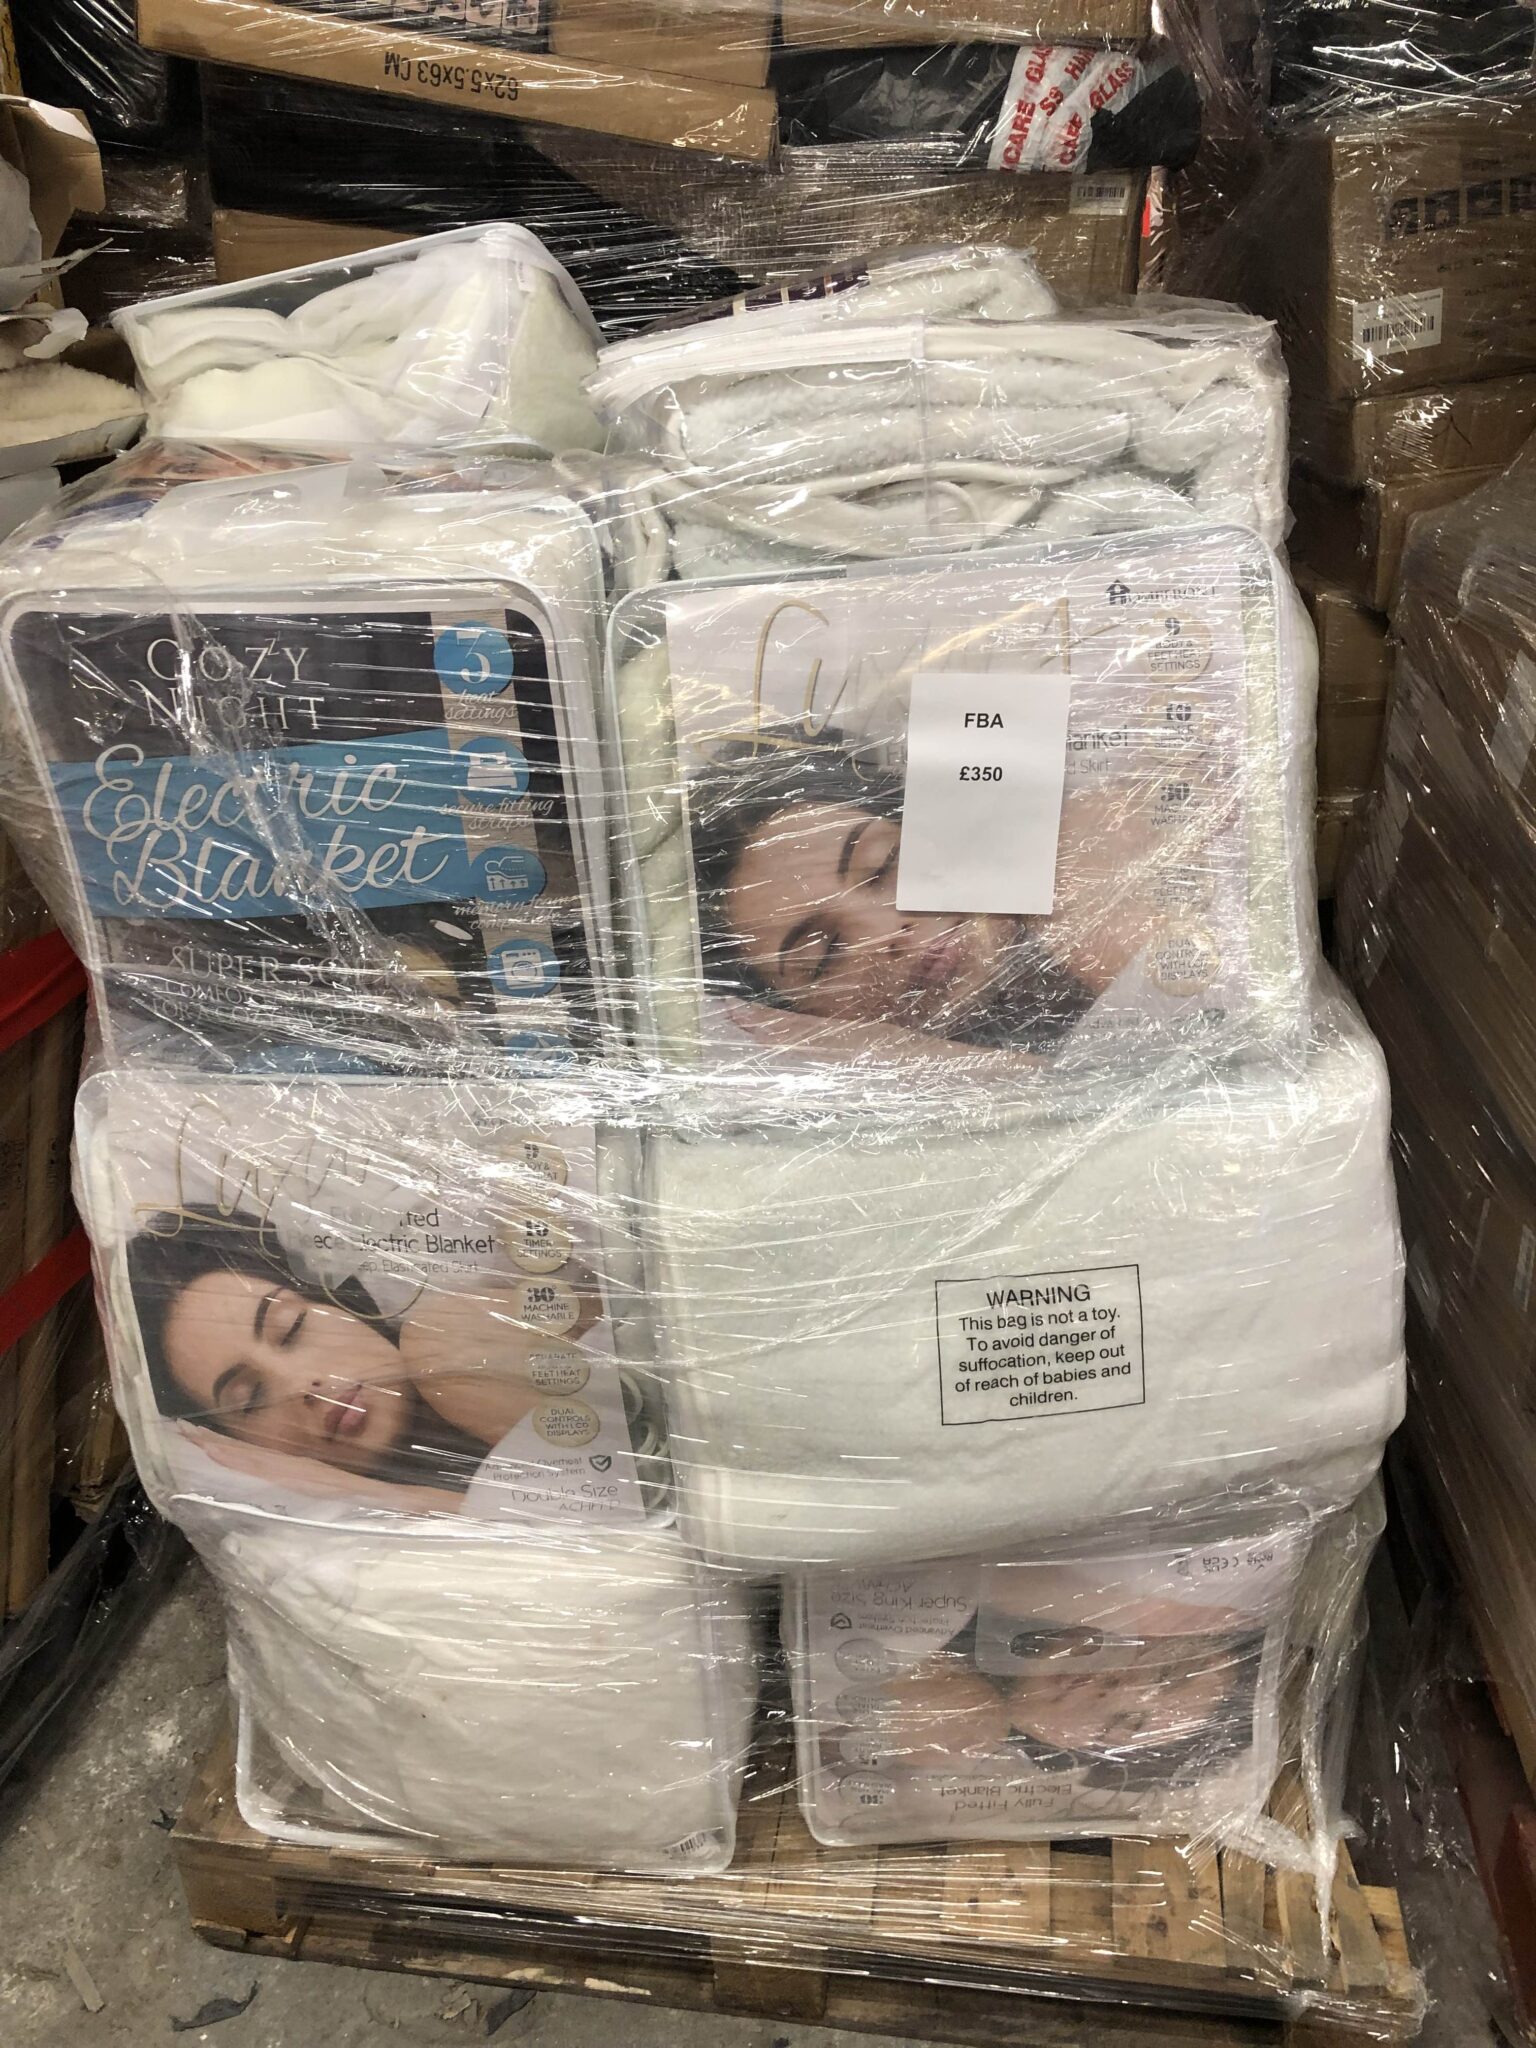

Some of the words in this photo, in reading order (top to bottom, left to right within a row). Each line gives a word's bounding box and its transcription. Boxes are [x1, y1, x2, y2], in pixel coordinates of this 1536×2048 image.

[1002, 99, 1036, 165] CARE
[147, 638, 309, 682] COZY
[456, 630, 491, 684] 3
[1150, 659, 1201, 672] SETTINGS
[444, 703, 518, 724] settings
[964, 712, 1004, 729] FBA
[959, 765, 1003, 782] £350
[83, 743, 408, 843] Elecric
[496, 797, 554, 816] fitting
[168, 944, 283, 985] SUPER
[425, 1233, 496, 1255] Blanket
[987, 1284, 1091, 1310] WARNING
[523, 1303, 570, 1313] MACHINE
[958, 1316, 993, 1332] This
[997, 1314, 1027, 1331] bag
[1031, 1312, 1044, 1327] is
[1047, 1310, 1074, 1325] not
[1078, 1311, 1088, 1322] a
[1092, 1307, 1121, 1323] toy.
[966, 1337, 988, 1352] To
[992, 1333, 1035, 1351] avoid
[1039, 1329, 1097, 1348] danger
[1100, 1325, 1116, 1340] of
[958, 1354, 1051, 1373] suffocation,
[1055, 1348, 1095, 1365] keep
[1099, 1344, 1126, 1359] out
[535, 1376, 581, 1387] SETTINGS
[955, 1378, 971, 1393] of
[974, 1374, 1019, 1392] reach
[1023, 1371, 1040, 1387] of
[1043, 1367, 1097, 1385] babies
[1101, 1362, 1131, 1378] and
[1009, 1389, 1078, 1407] children.
[539, 1415, 591, 1424] CONTROLS
[550, 1407, 576, 1417] DUAL
[580, 1483, 619, 1498] Size
[873, 1591, 912, 1610] King
[919, 1593, 968, 1612] Super
[940, 1784, 1001, 1798] Blanket
[1008, 1783, 1073, 1797] Electric
[954, 1799, 1008, 1812] Fitted
[1013, 1797, 1055, 1809] Fully
